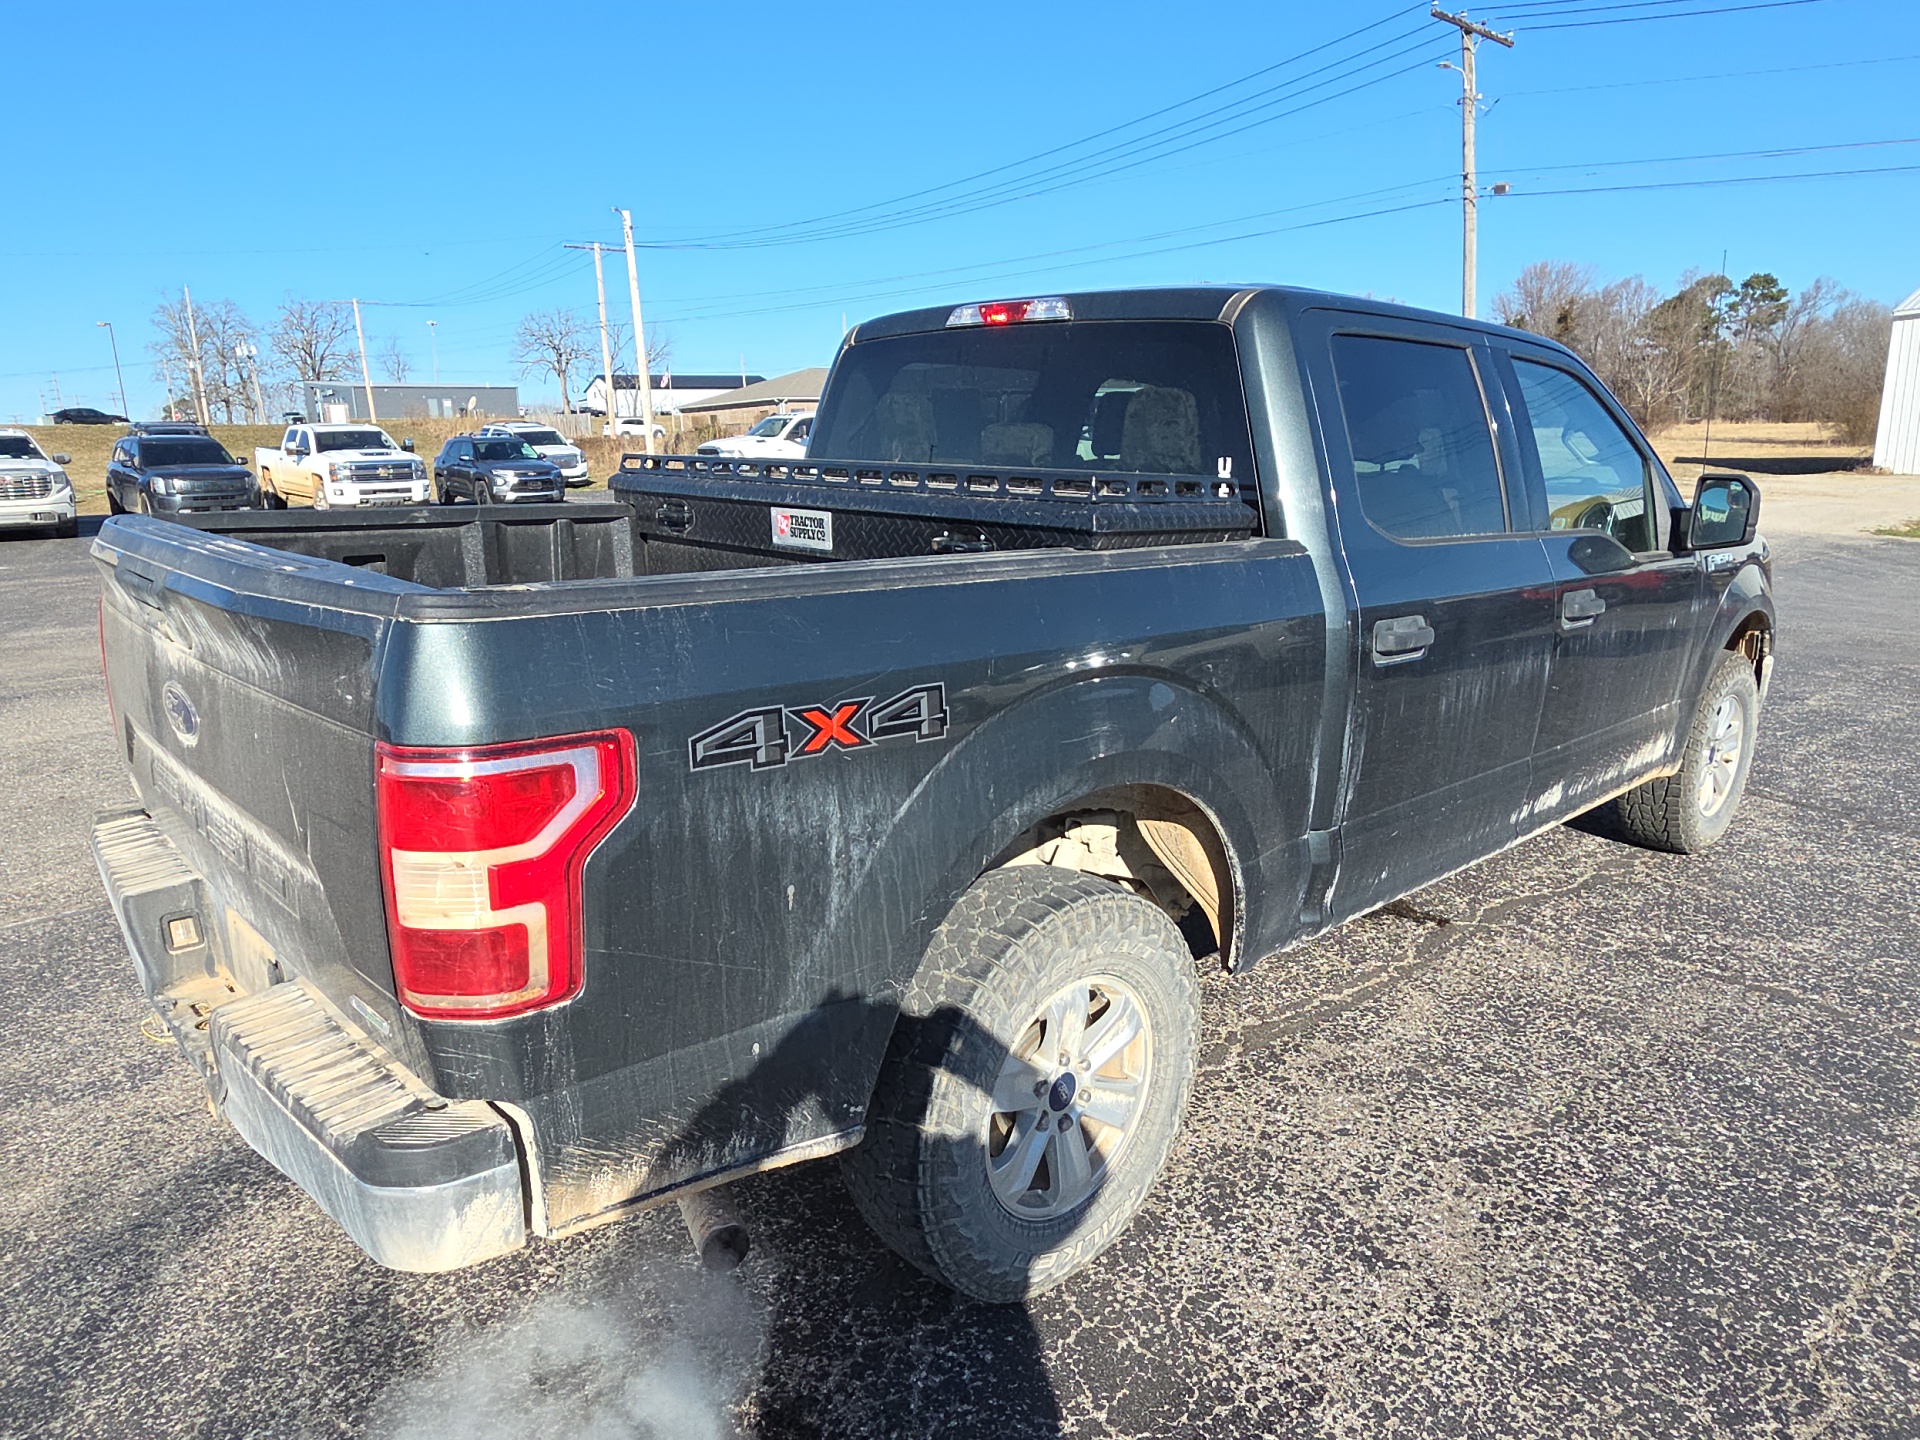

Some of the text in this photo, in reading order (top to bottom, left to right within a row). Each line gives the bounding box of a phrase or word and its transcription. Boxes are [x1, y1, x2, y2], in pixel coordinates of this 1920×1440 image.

[790, 515, 825, 529] TRACTOR
[790, 527, 816, 541] SUPPLY
[688, 682, 949, 772] 4X4
